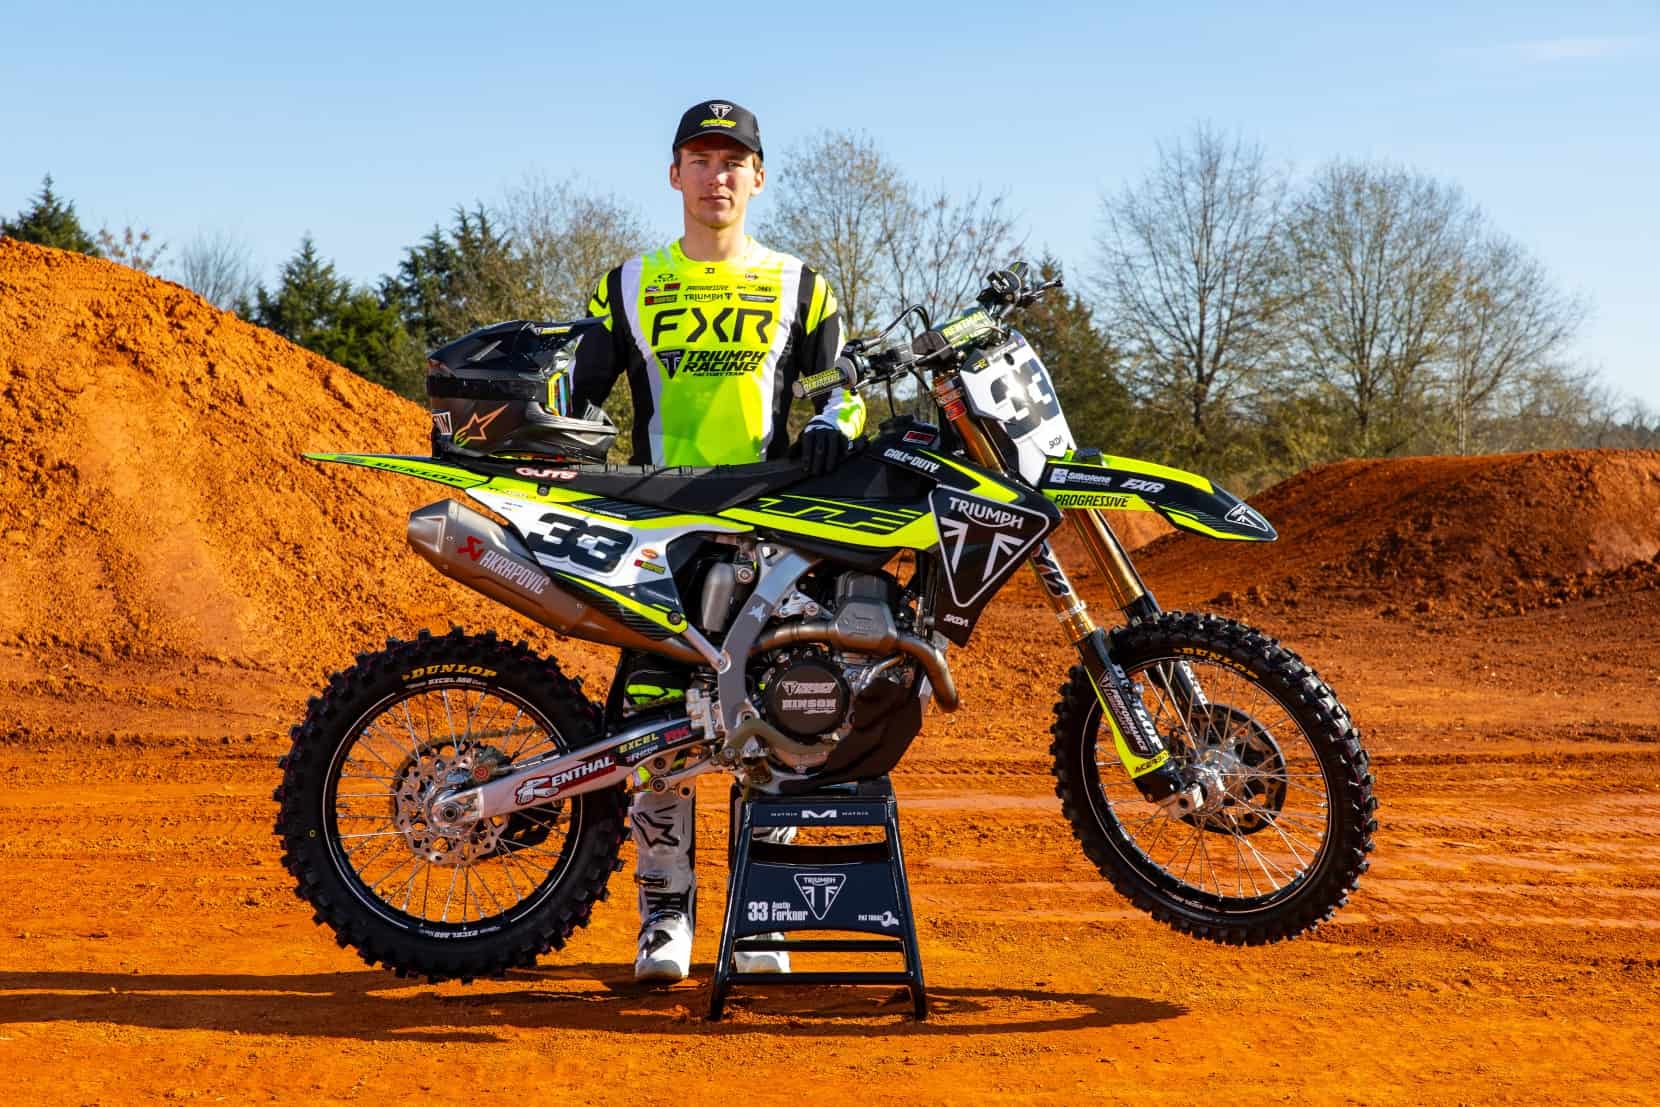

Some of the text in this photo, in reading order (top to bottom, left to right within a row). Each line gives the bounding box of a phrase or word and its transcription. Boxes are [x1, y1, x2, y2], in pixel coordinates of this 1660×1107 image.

[683, 293, 724, 302] TRIUMPH
[651, 307, 773, 347] FXR
[687, 350, 767, 362] TRIUMPH
[682, 362, 760, 373] RACING
[883, 448, 908, 461] CALL
[912, 456, 941, 474] DUTY
[1120, 478, 1166, 493] FXR
[1054, 494, 1130, 508] PROGRESSIVE
[948, 497, 1025, 530] TRIUMPH
[526, 513, 634, 573] 33
[410, 664, 497, 680] DUNLOP
[1110, 685, 1149, 752] PERFORMANCE
[619, 733, 660, 753] EXCEL
[803, 876, 836, 885] TRIUMPH
[748, 901, 769, 922] 33
